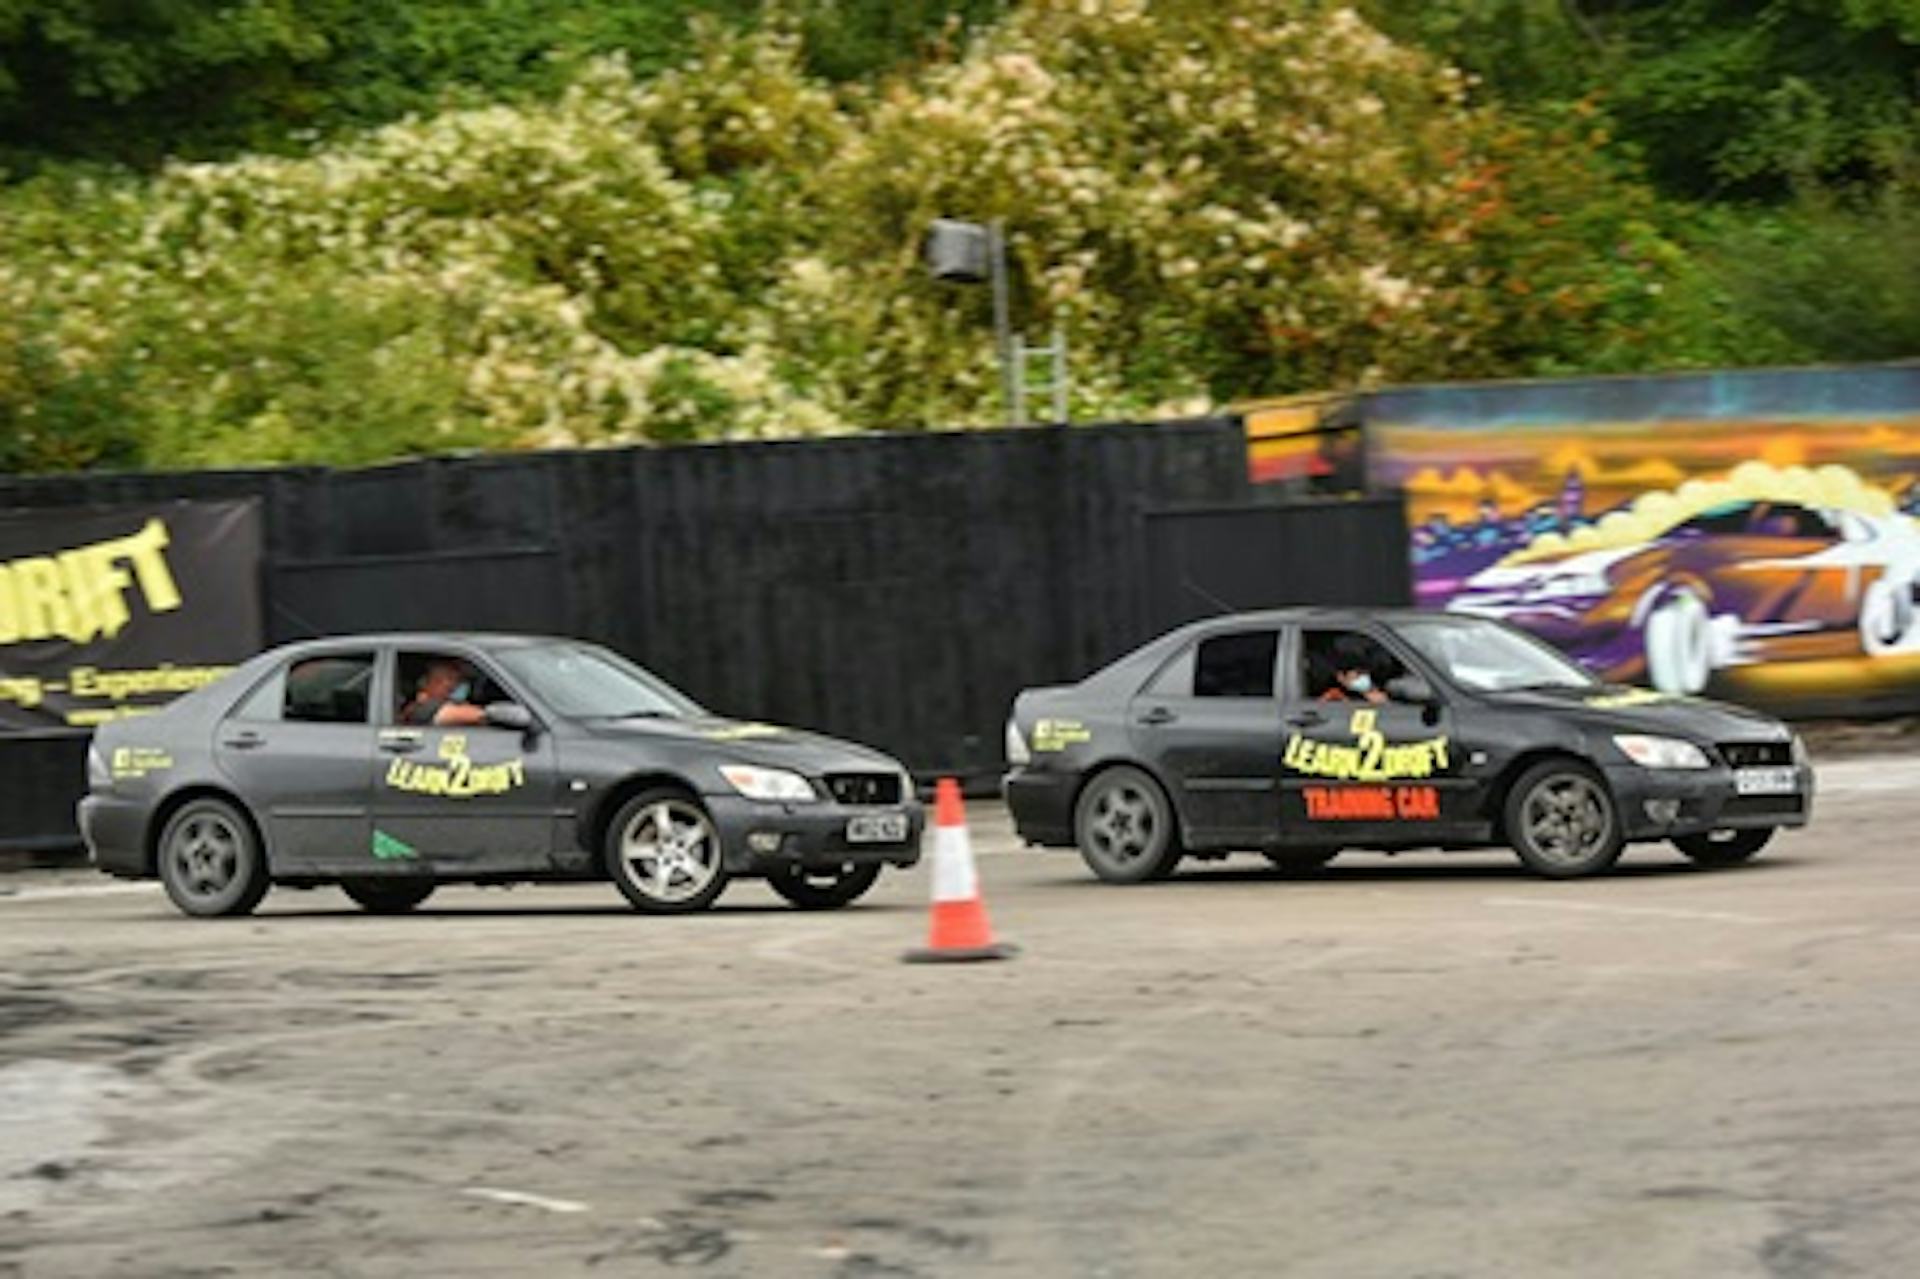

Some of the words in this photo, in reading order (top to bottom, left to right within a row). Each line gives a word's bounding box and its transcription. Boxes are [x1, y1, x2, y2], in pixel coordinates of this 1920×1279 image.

[70, 664, 239, 698] Experienc
[1303, 786, 1395, 819] TRAINING
[1399, 786, 1440, 819] CAR
